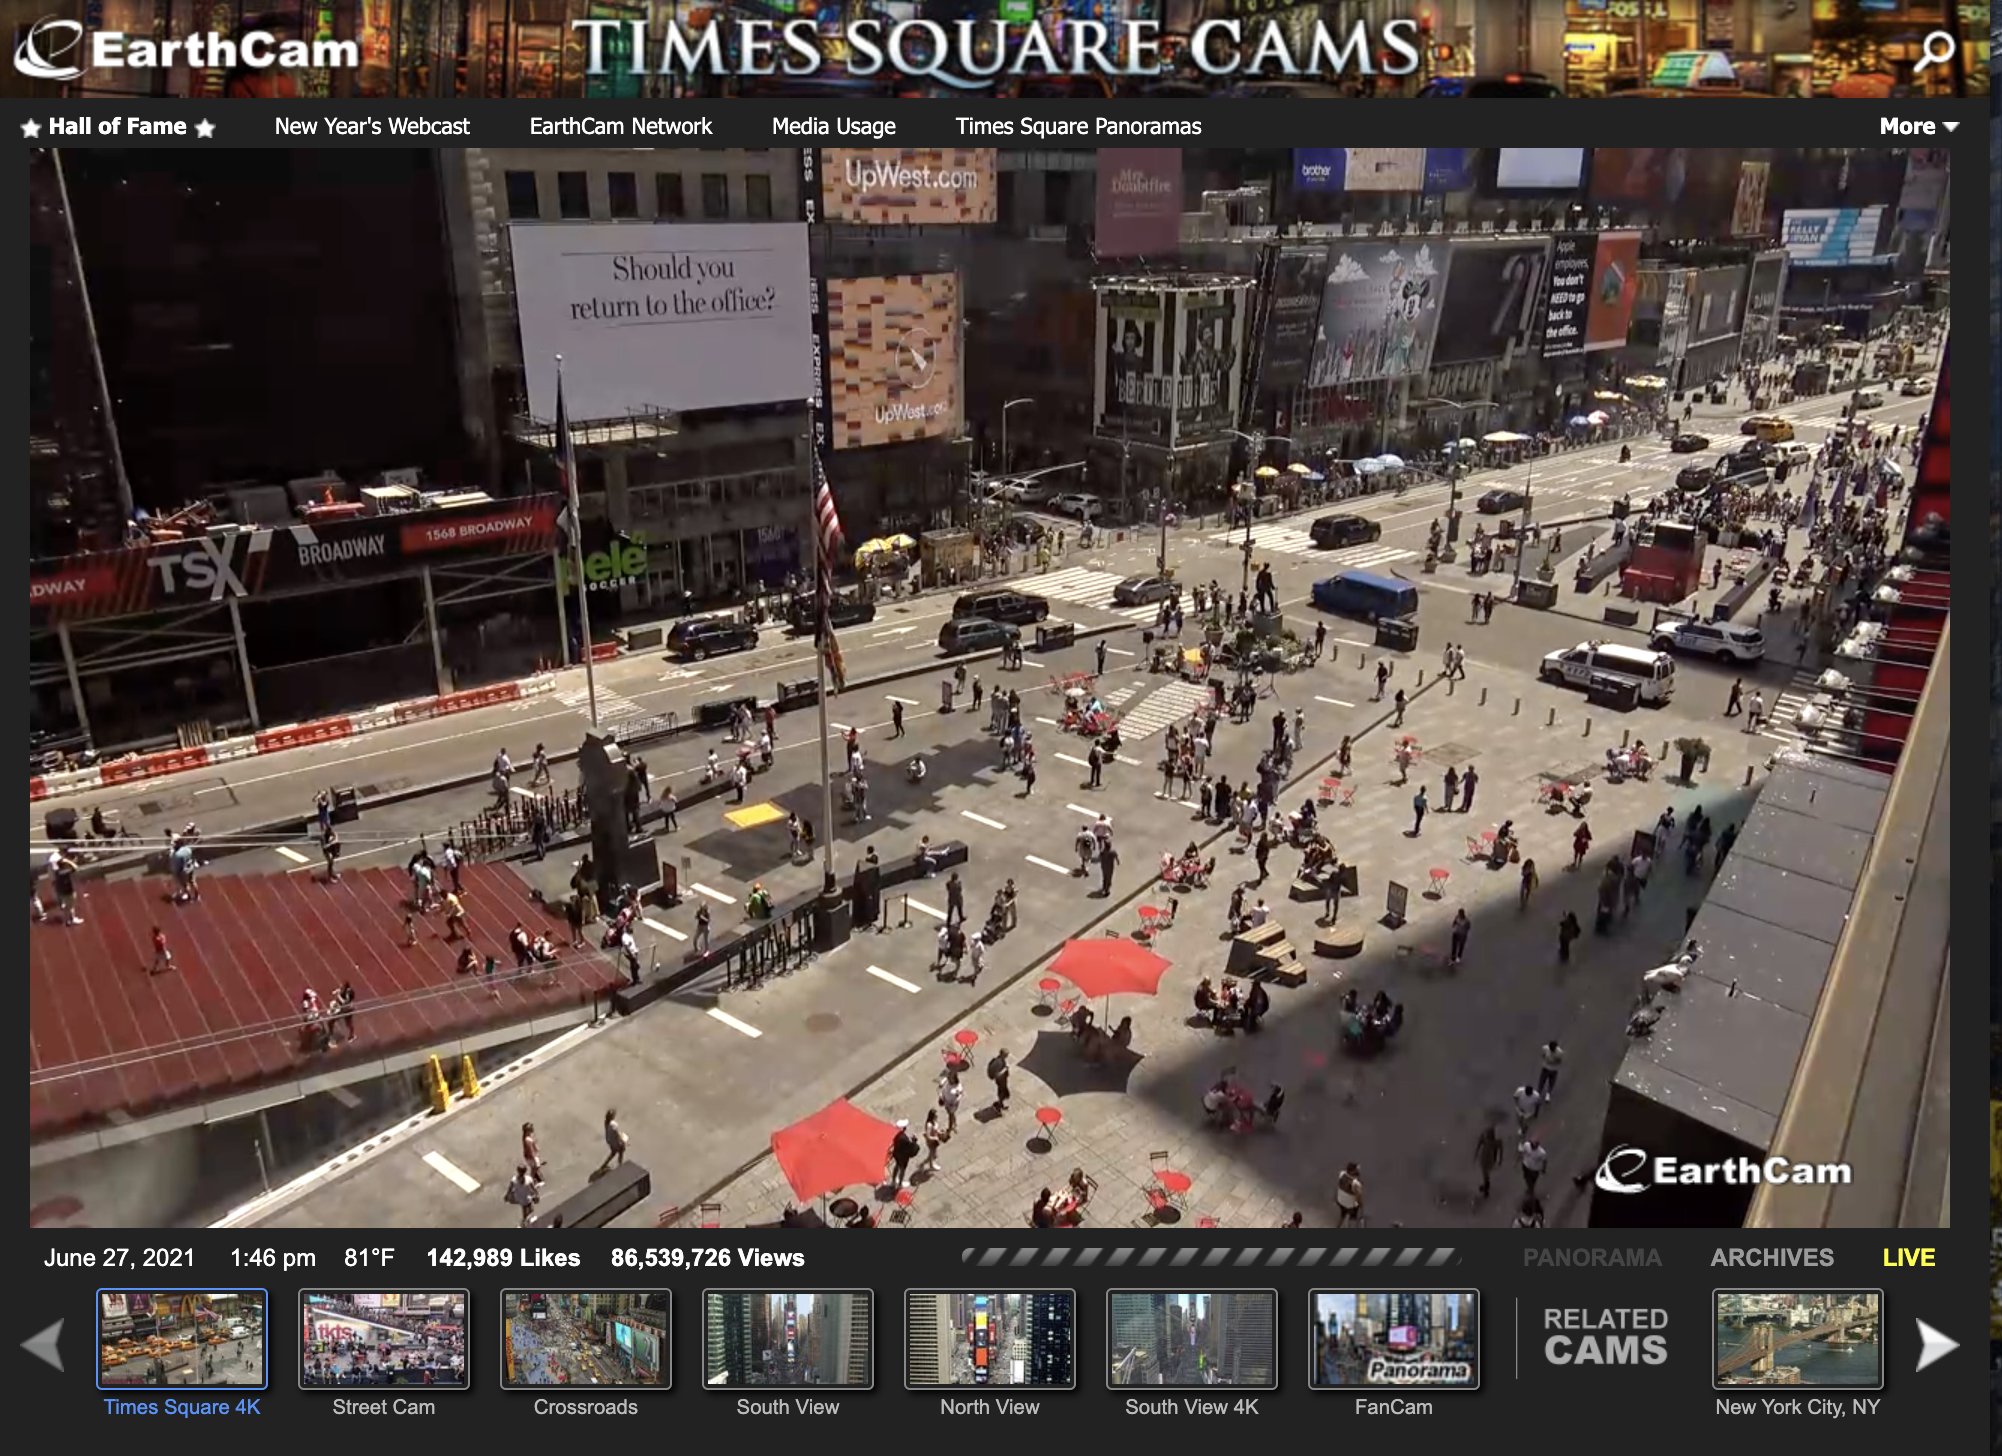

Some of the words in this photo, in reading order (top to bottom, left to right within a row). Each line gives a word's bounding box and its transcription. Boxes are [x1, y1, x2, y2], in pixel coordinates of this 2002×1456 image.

[845, 158, 978, 193] UpWest.com
[613, 251, 691, 281] Should
[696, 260, 735, 285] you
[1553, 274, 1565, 287] You
[1565, 273, 1585, 286] don't
[571, 296, 640, 320] return
[646, 294, 667, 317] to
[673, 289, 707, 315] the
[706, 286, 776, 312] office?
[1550, 292, 1568, 304] NEED
[1576, 292, 1586, 305] go
[1548, 309, 1565, 322] back
[1545, 326, 1557, 339] the
[426, 525, 456, 542] 1568
[459, 516, 534, 538] BROADWAY
[147, 532, 249, 601] TSX
[298, 534, 385, 567] BROADWAY
[30, 578, 86, 599] DWAY
